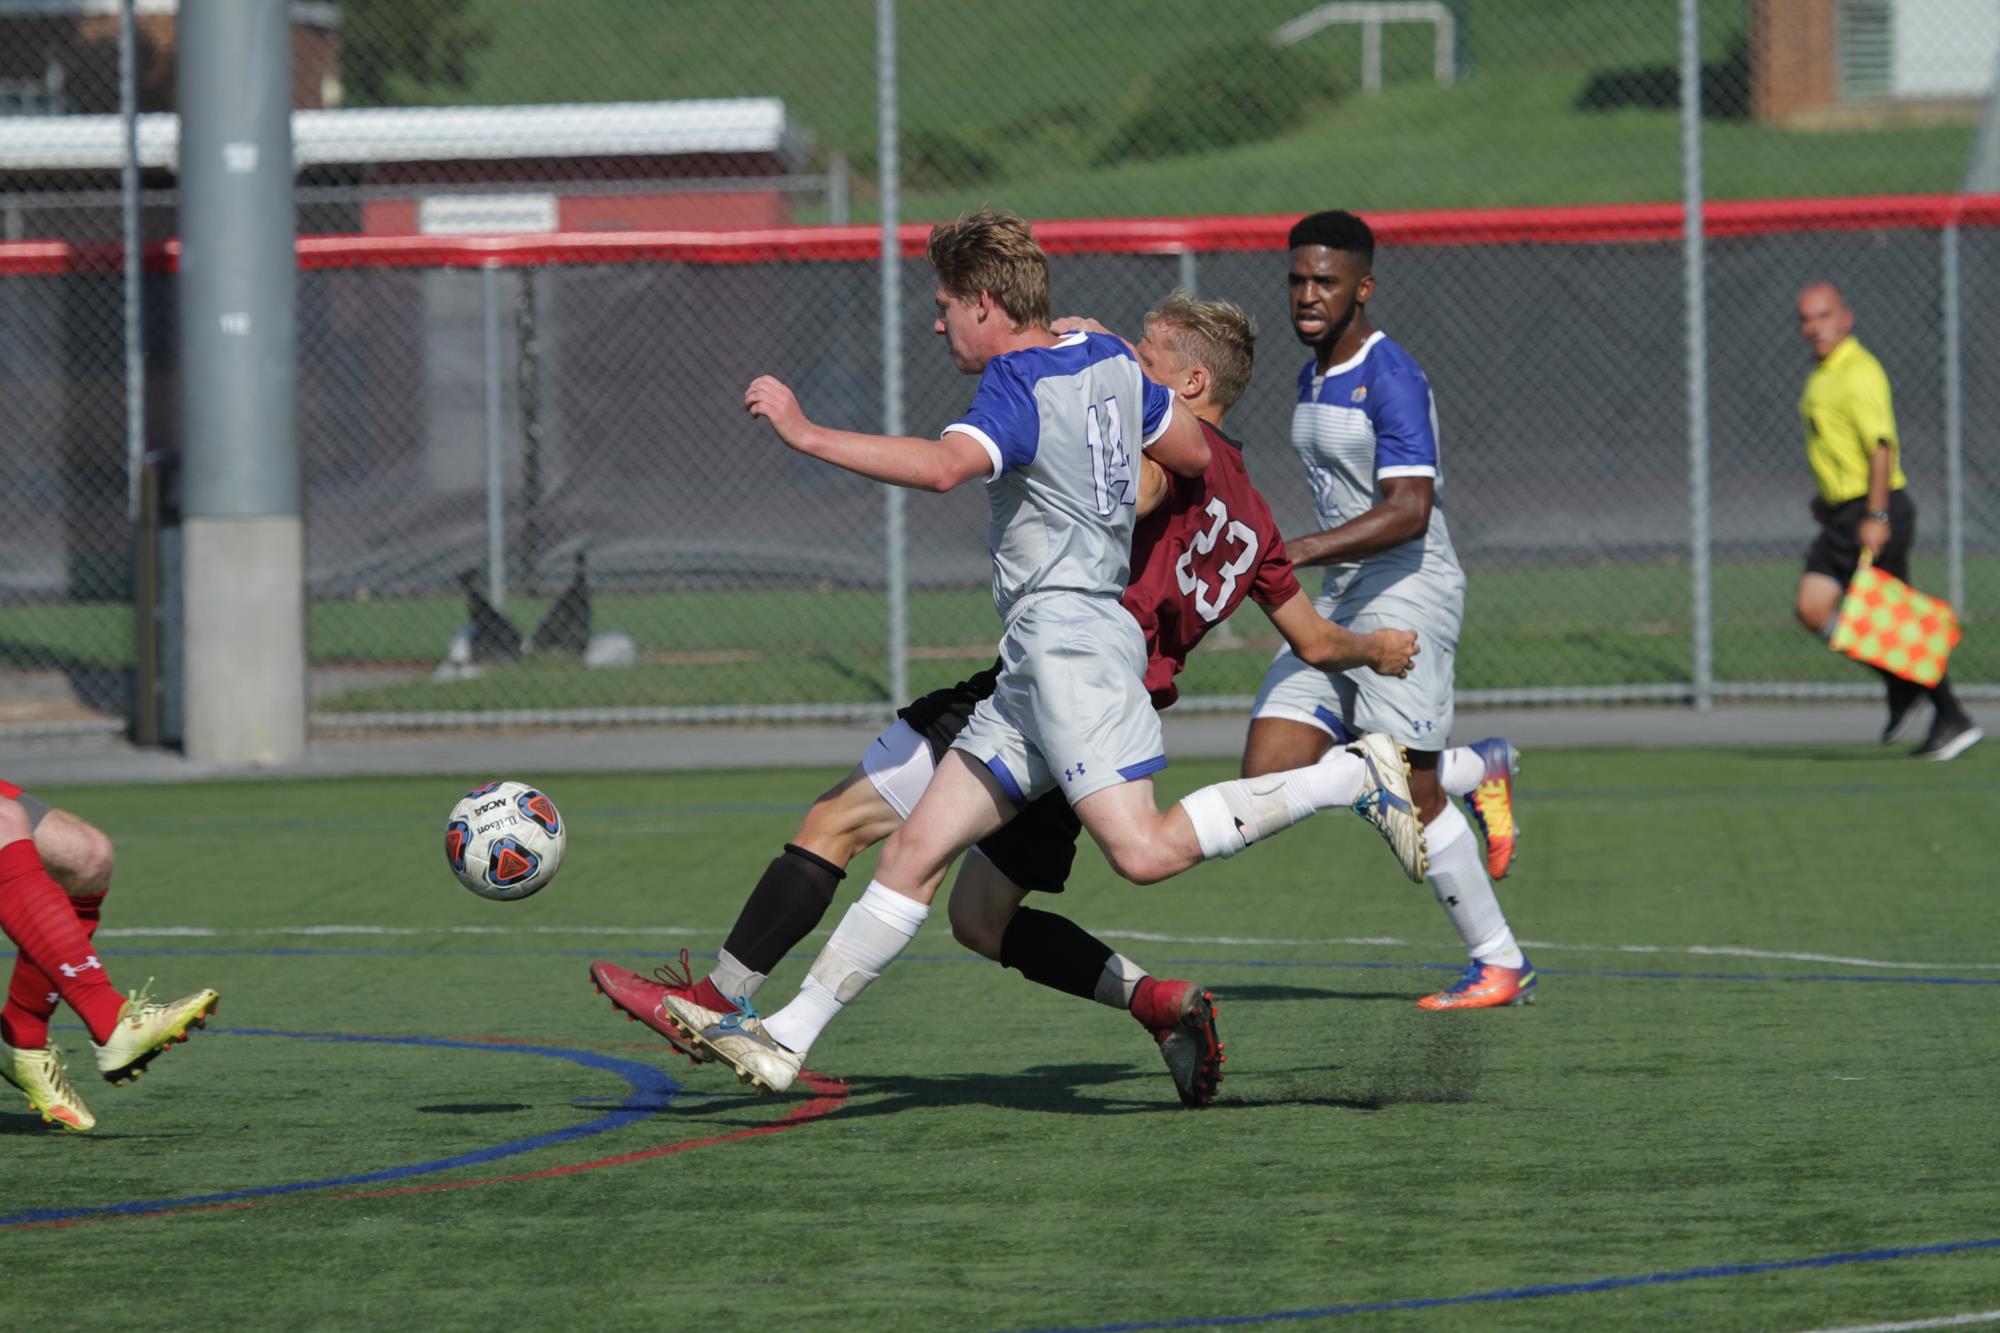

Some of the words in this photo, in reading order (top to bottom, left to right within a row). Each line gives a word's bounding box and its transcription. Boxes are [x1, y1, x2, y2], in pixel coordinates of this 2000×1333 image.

[1087, 396, 1136, 516] 14
[1175, 496, 1260, 623] 23
[474, 798, 507, 816] NCAA
[477, 815, 518, 834] Wilson
